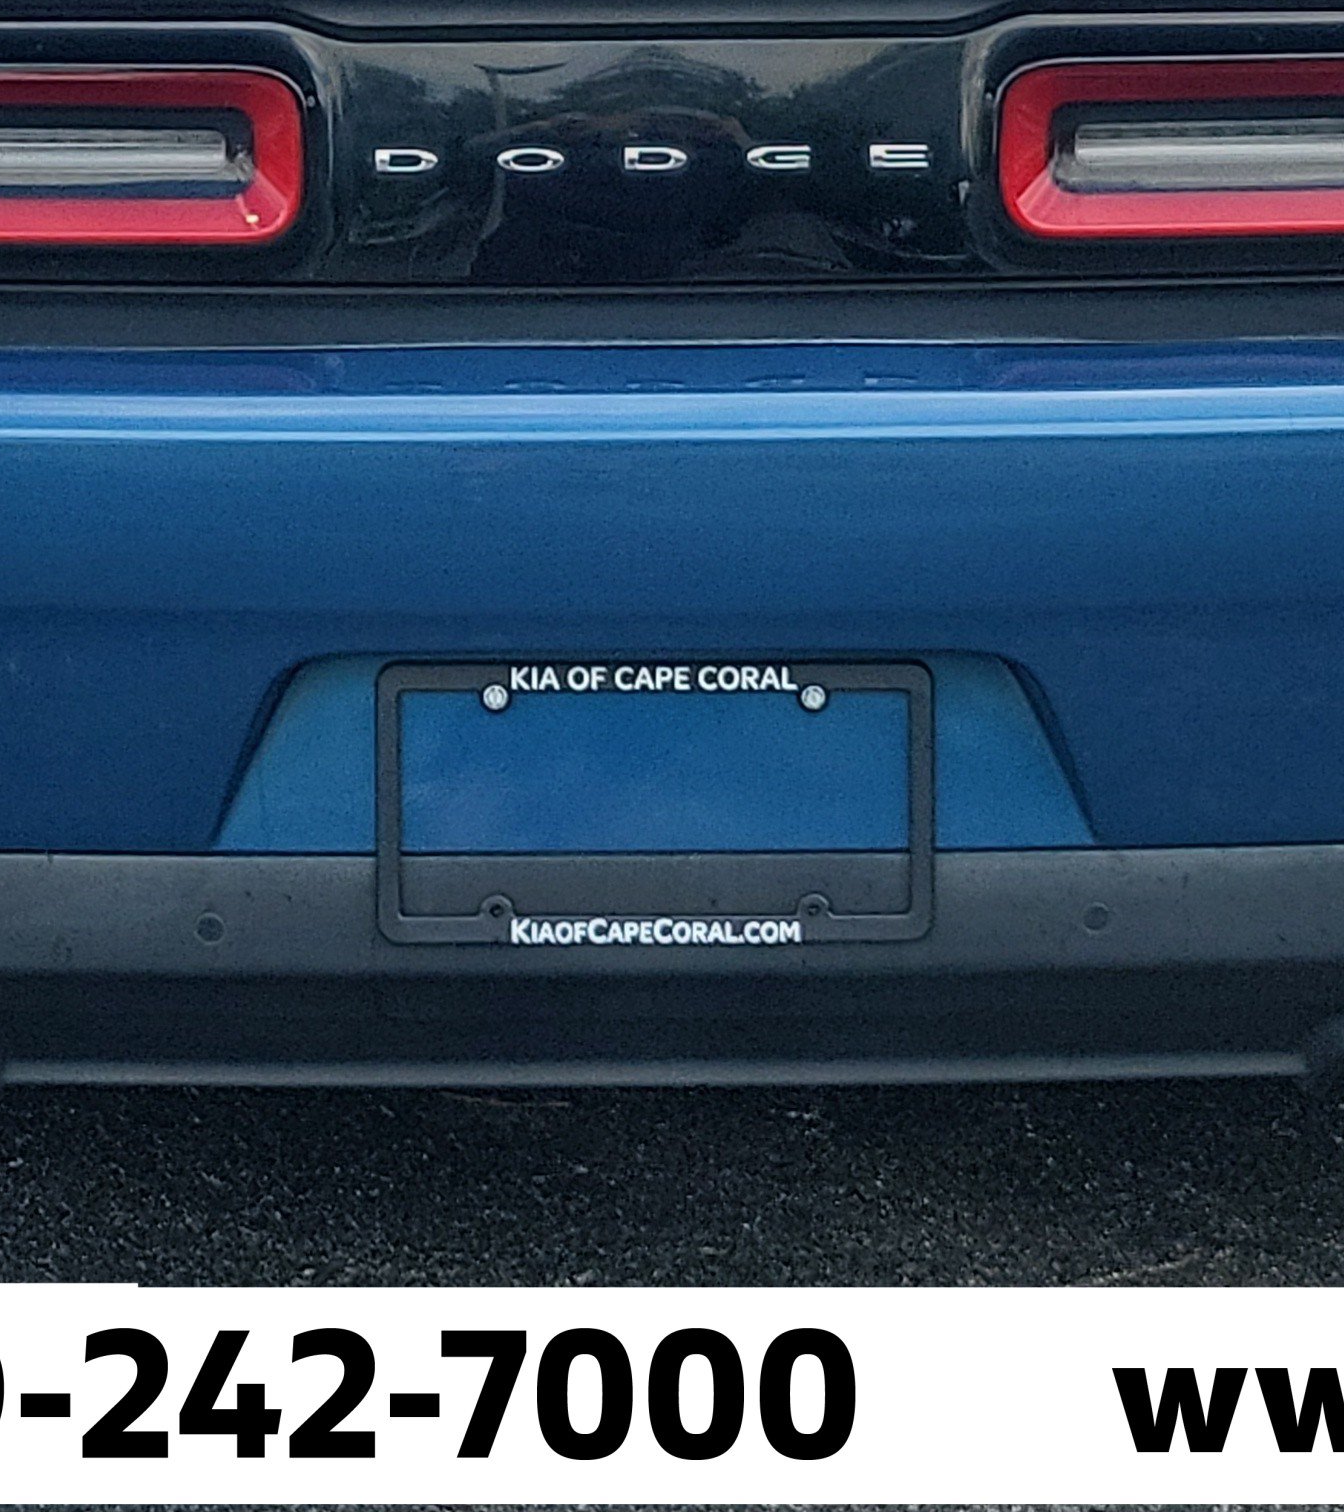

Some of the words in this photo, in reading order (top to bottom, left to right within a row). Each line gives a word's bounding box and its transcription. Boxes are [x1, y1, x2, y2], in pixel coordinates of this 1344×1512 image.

[373, 143, 931, 174] DODGE
[510, 665, 560, 691] KIA
[566, 665, 608, 691] OF
[613, 665, 691, 691] CAPE
[697, 665, 799, 691] CORAL
